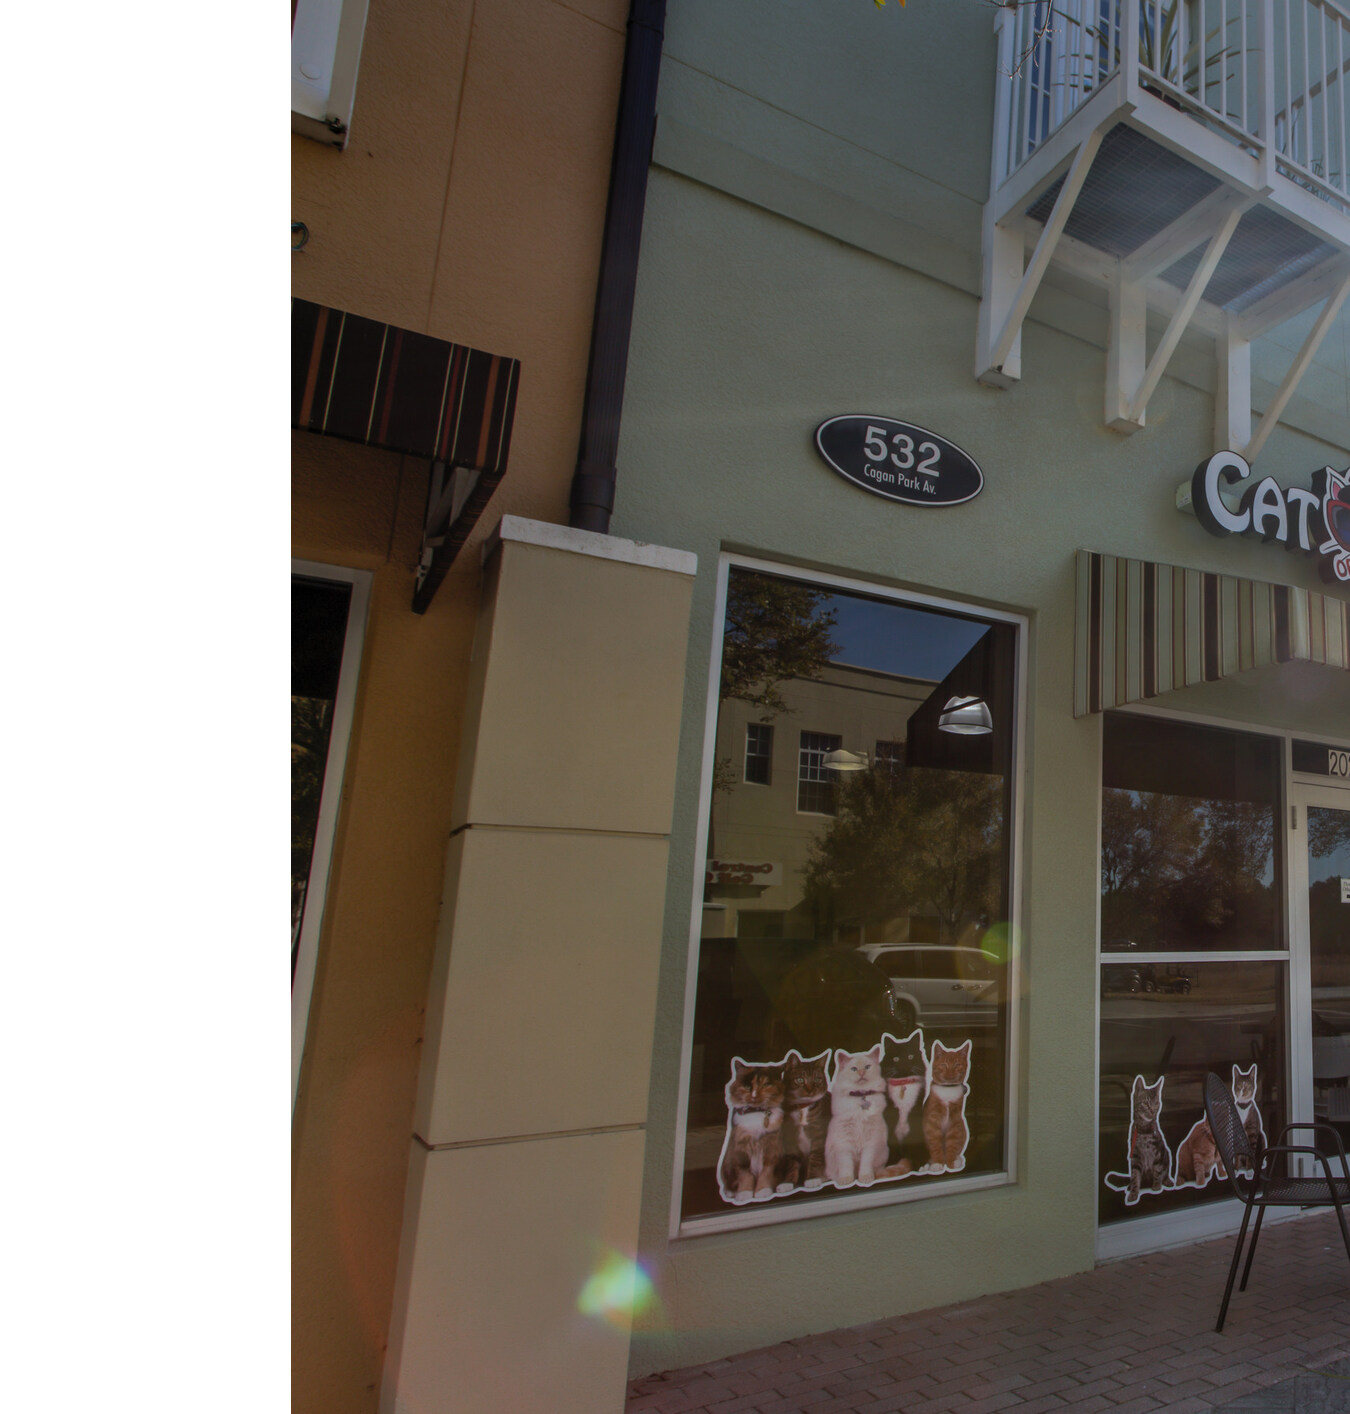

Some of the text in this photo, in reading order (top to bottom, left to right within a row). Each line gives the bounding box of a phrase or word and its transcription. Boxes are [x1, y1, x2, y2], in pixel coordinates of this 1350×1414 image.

[863, 425, 941, 478] 532
[863, 463, 937, 495] Cagan Park Av.
[1204, 450, 1320, 551] CAT
